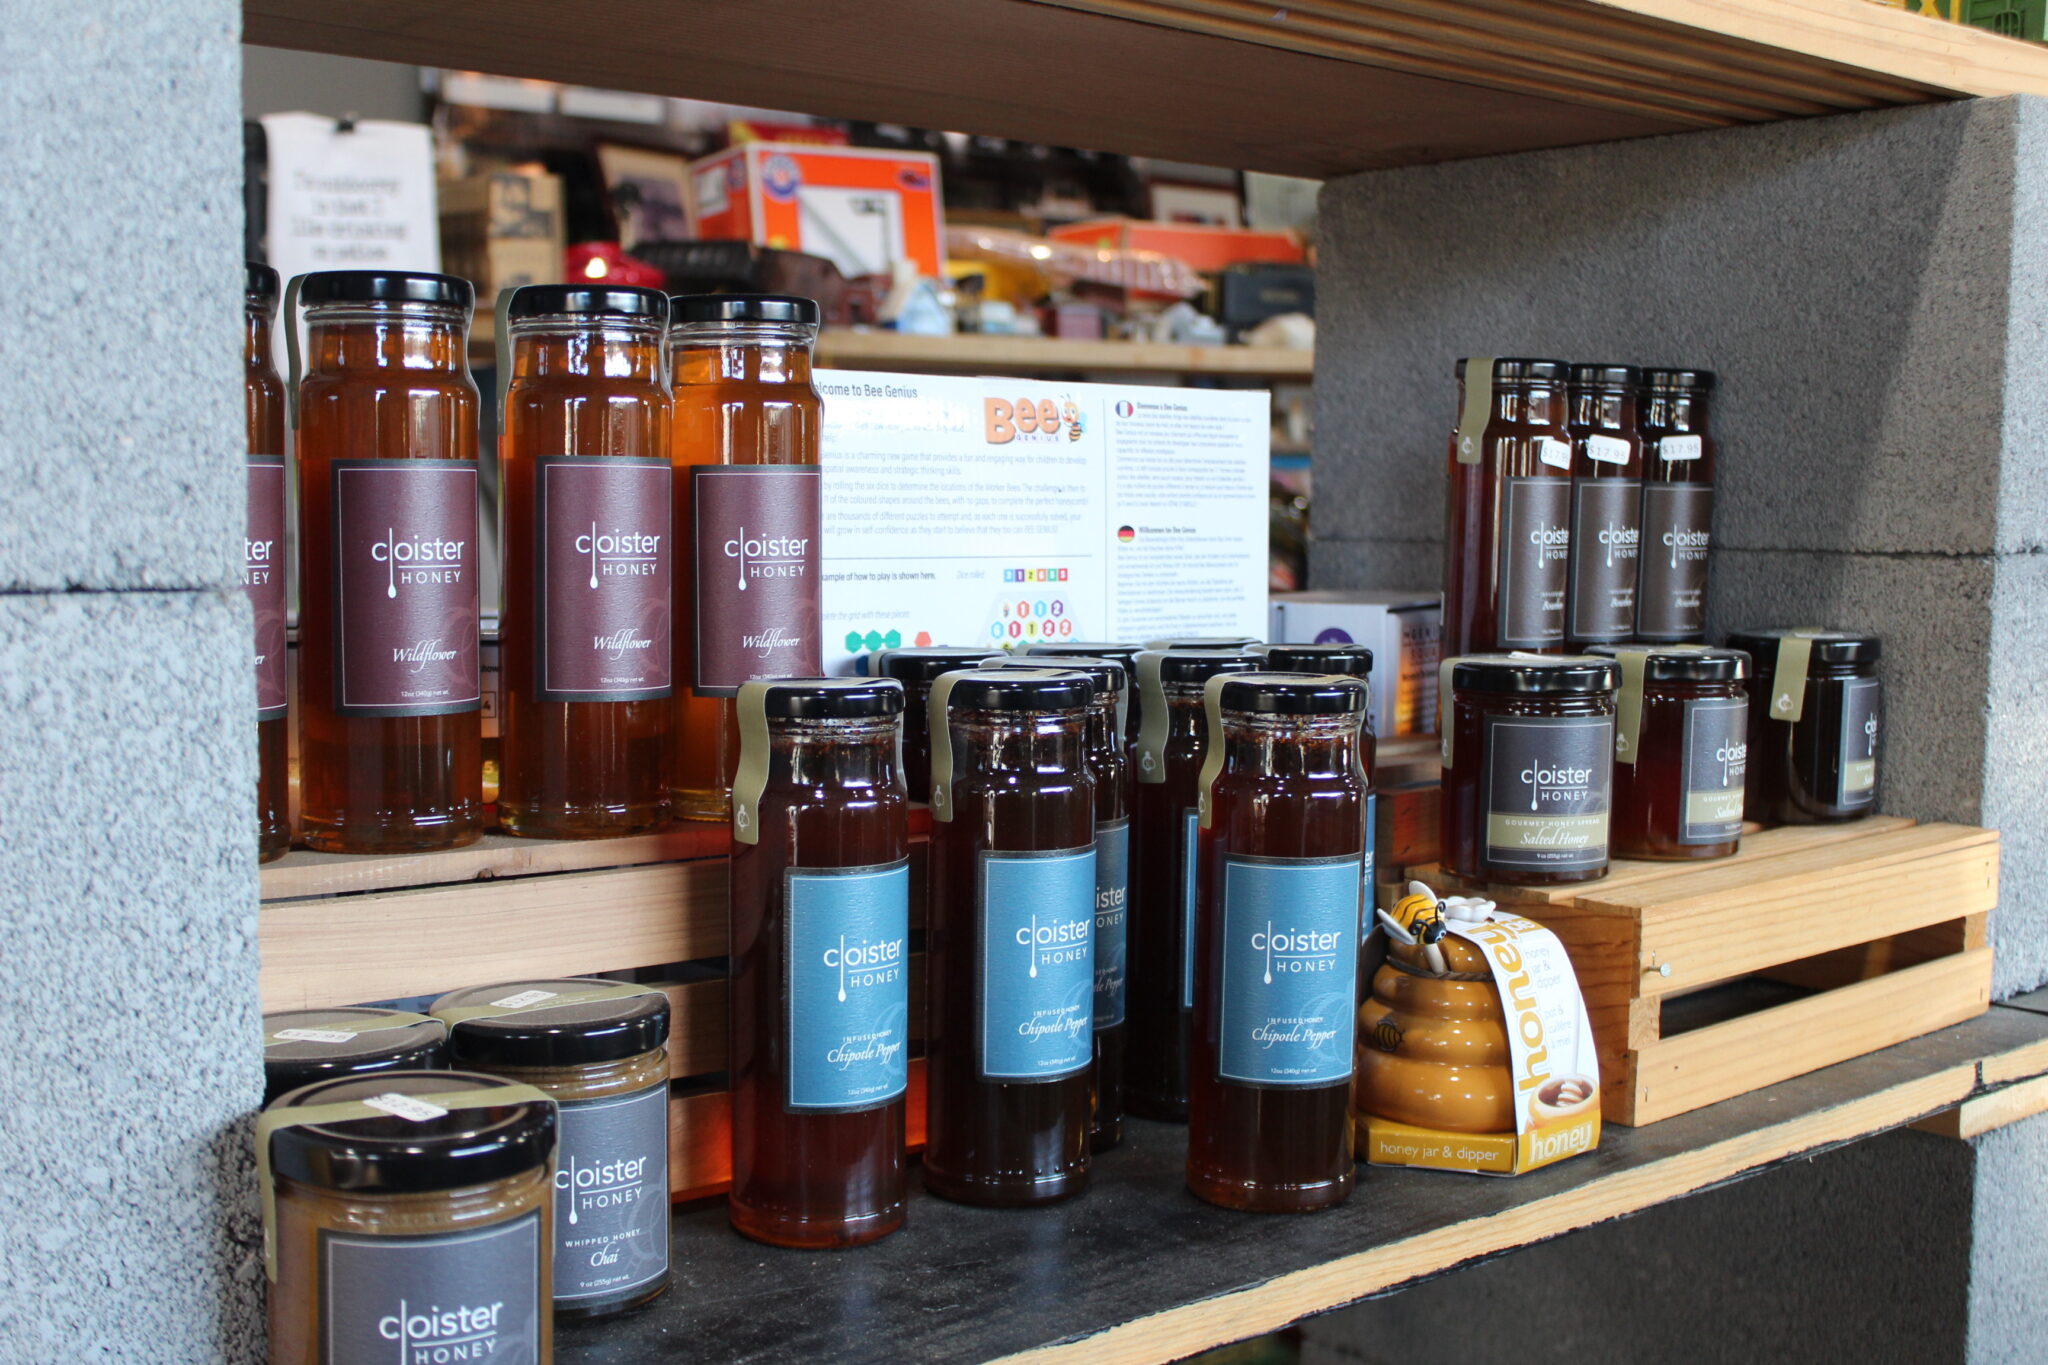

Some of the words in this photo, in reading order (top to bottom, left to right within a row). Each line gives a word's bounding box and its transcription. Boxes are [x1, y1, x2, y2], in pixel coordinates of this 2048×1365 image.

[815, 381, 850, 396] elcome
[852, 383, 862, 397] to
[864, 384, 883, 398] Bee
[885, 385, 918, 399] Genius
[983, 397, 1061, 444] Bee
[371, 527, 465, 583] cloister
[575, 521, 661, 576] cloister
[724, 526, 808, 578] cloister
[240, 571, 270, 585] NEY
[401, 571, 462, 585] HONEY
[603, 563, 658, 576] HONEY
[750, 565, 806, 579] HONEY
[821, 572, 845, 582] ample
[846, 571, 854, 581] of
[854, 571, 868, 581] how
[869, 571, 876, 581] to
[877, 571, 891, 582] play
[899, 571, 920, 580] shown
[393, 638, 457, 673] Wildflower
[594, 628, 652, 661] Wildflower
[742, 627, 800, 659] Wildflower
[1520, 759, 1593, 801] cloister
[1541, 791, 1589, 801] HONEY
[1505, 819, 1545, 827] GOURMET
[1520, 826, 1562, 845] Salted
[1558, 831, 1590, 848] Honey
[1096, 887, 1126, 909] ister
[1096, 912, 1124, 928] ONEY
[1016, 914, 1091, 966] cloister
[1251, 920, 1342, 972] cloister
[823, 934, 903, 990] cloister
[1041, 947, 1088, 965] HONEY
[1276, 959, 1336, 973] HONEY
[850, 968, 900, 988] HONEY
[1466, 924, 1552, 1092] honey
[1018, 1012, 1063, 1043] Chipotle
[1063, 1016, 1088, 1039] Pepper
[1267, 1017, 1304, 1026] INFUSED
[843, 1032, 876, 1043] INFUSED
[1251, 1023, 1301, 1050] Chipotle
[1302, 1027, 1337, 1050] Pepper
[827, 1038, 875, 1072] Chipotle
[874, 1041, 902, 1065] Pepper
[1379, 1142, 1419, 1158] honey
[1421, 1143, 1440, 1160] jar
[1442, 1144, 1452, 1158] &
[1456, 1145, 1500, 1164] dipper
[1528, 1120, 1593, 1165] honey
[554, 1155, 647, 1211] cloister
[582, 1186, 643, 1210] HONEY
[565, 1236, 609, 1248] WHIPPED
[613, 1228, 641, 1241] HONEY
[590, 1240, 620, 1267] Chai
[415, 1337, 496, 1365] HONEY
